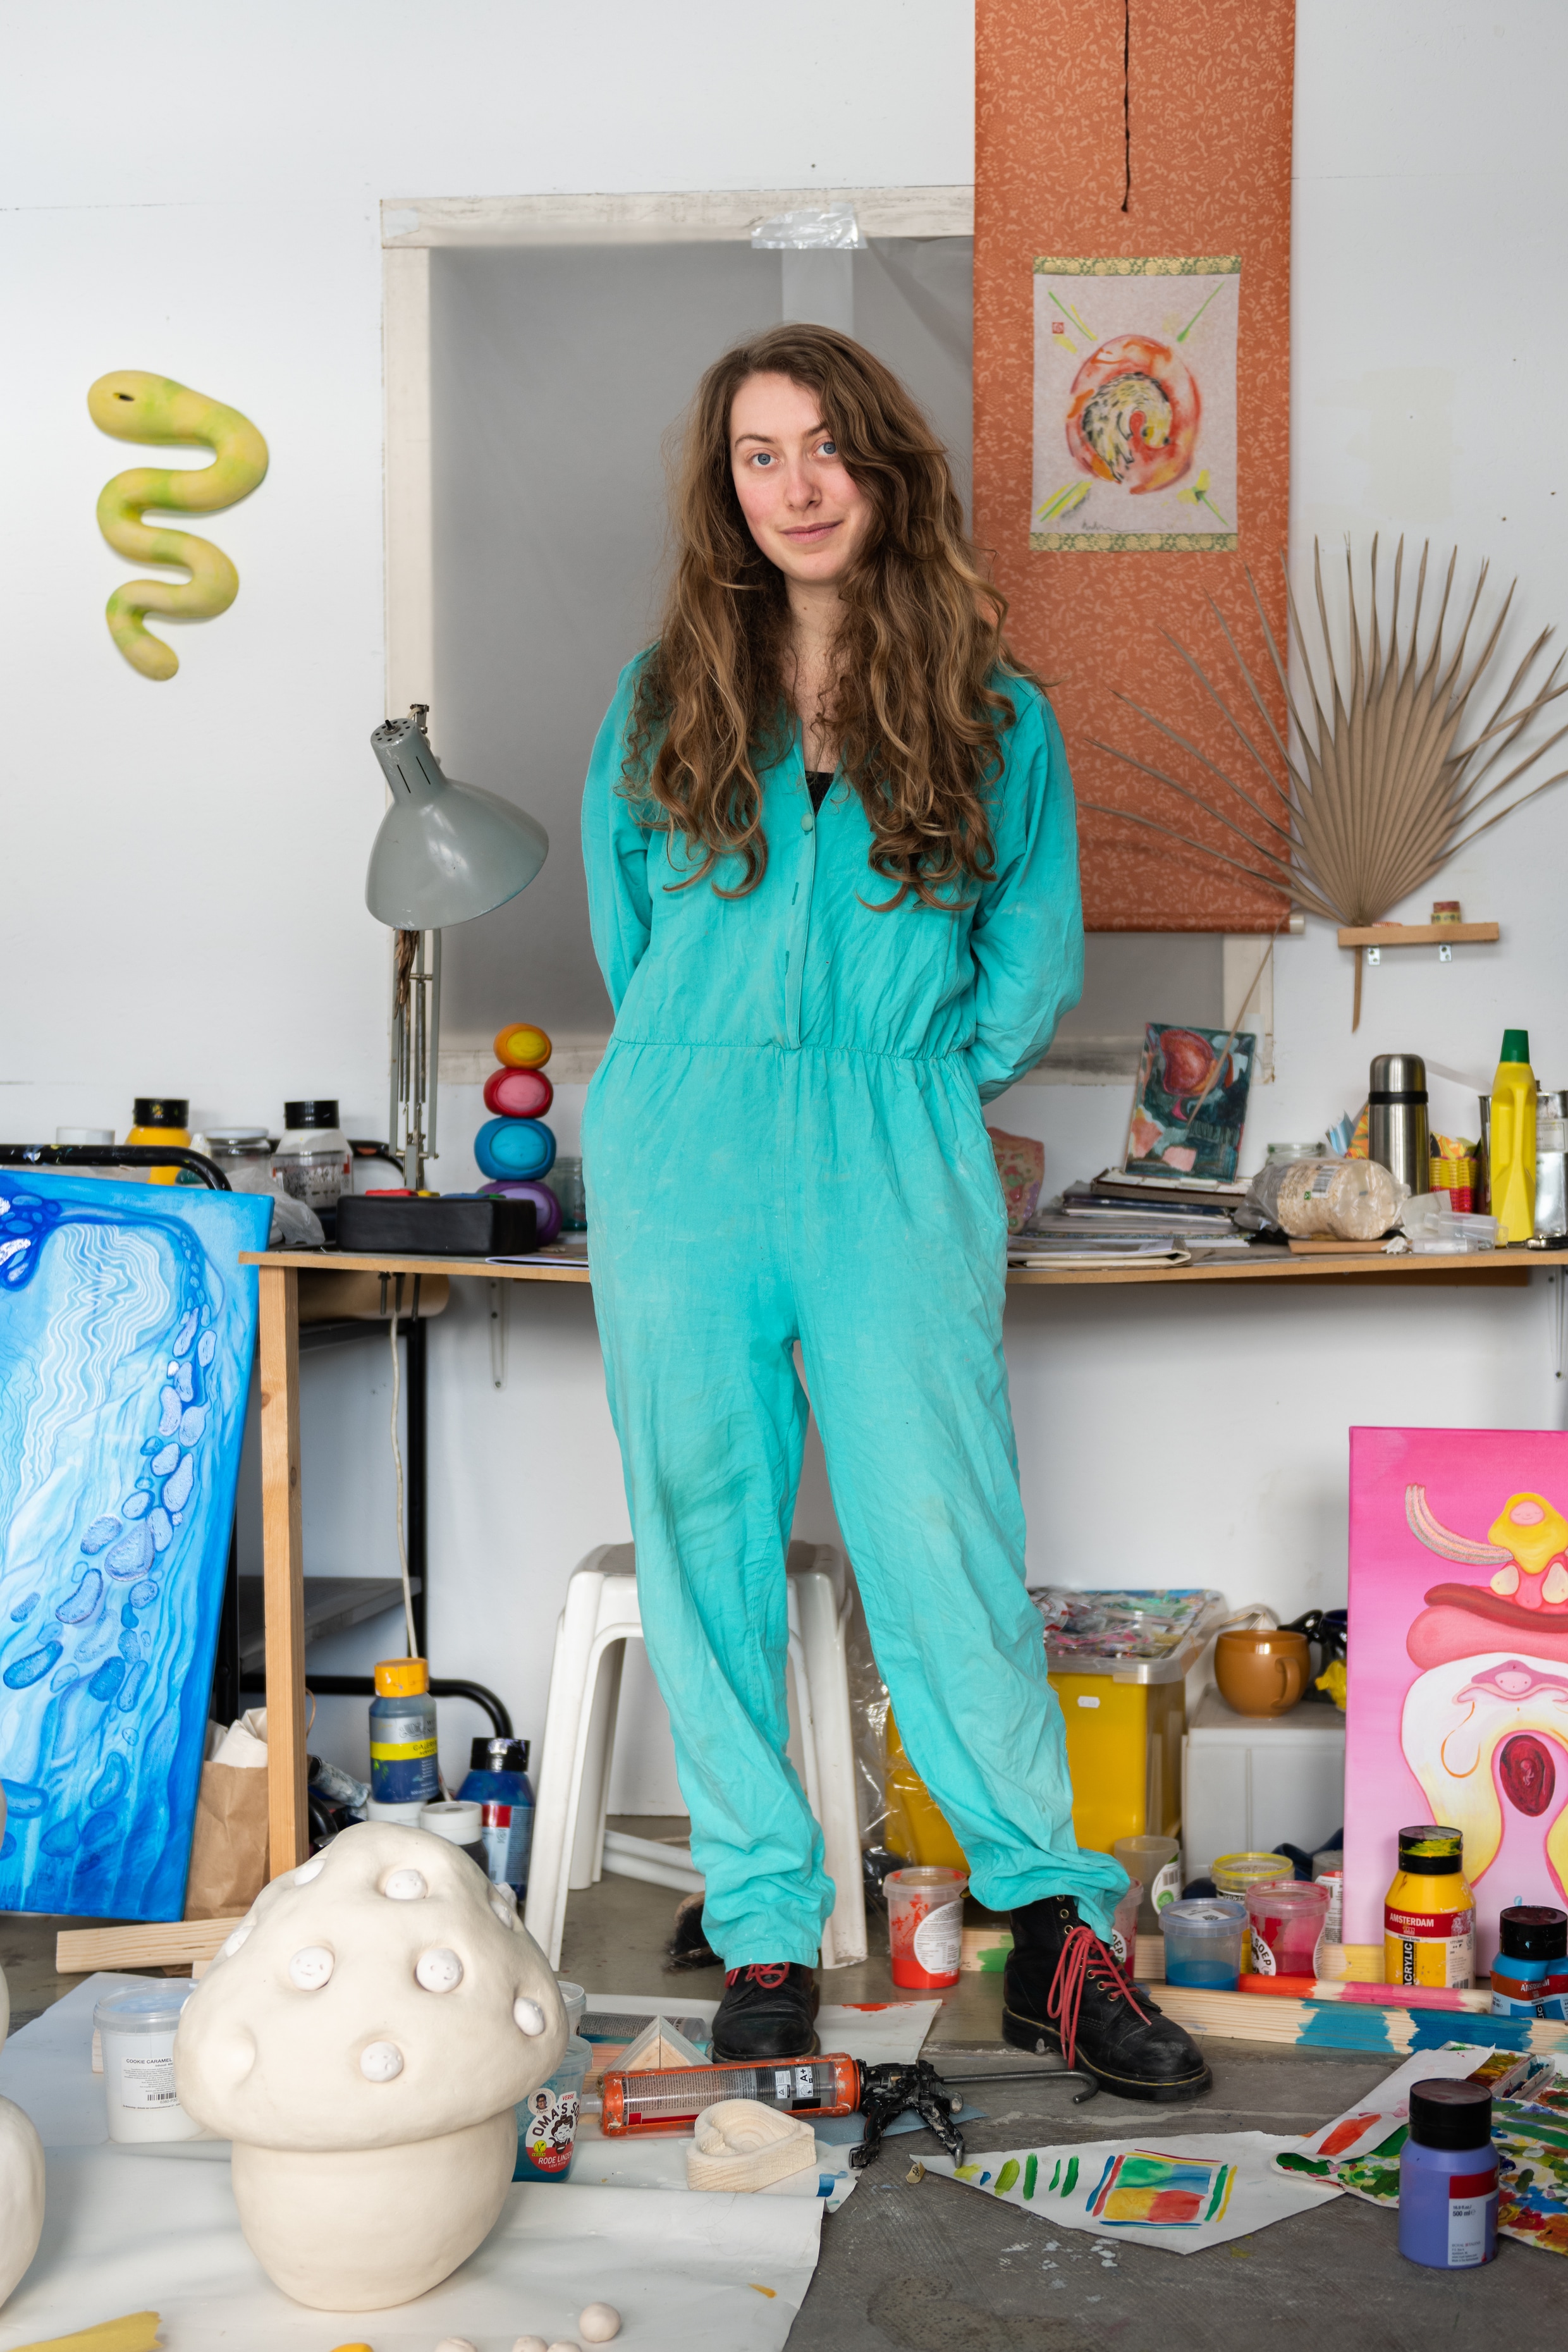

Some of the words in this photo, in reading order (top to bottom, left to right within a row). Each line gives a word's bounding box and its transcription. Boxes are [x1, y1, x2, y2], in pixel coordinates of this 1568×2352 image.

[1390, 1913, 1434, 1927] AMSTERDAM
[1255, 1938, 1272, 1966] SOEP
[1521, 1978, 1550, 1992] AMSTERDAM
[800, 2068, 808, 2082] A+
[532, 2102, 568, 2136] OMA'S
[538, 2157, 556, 2165] RODE
